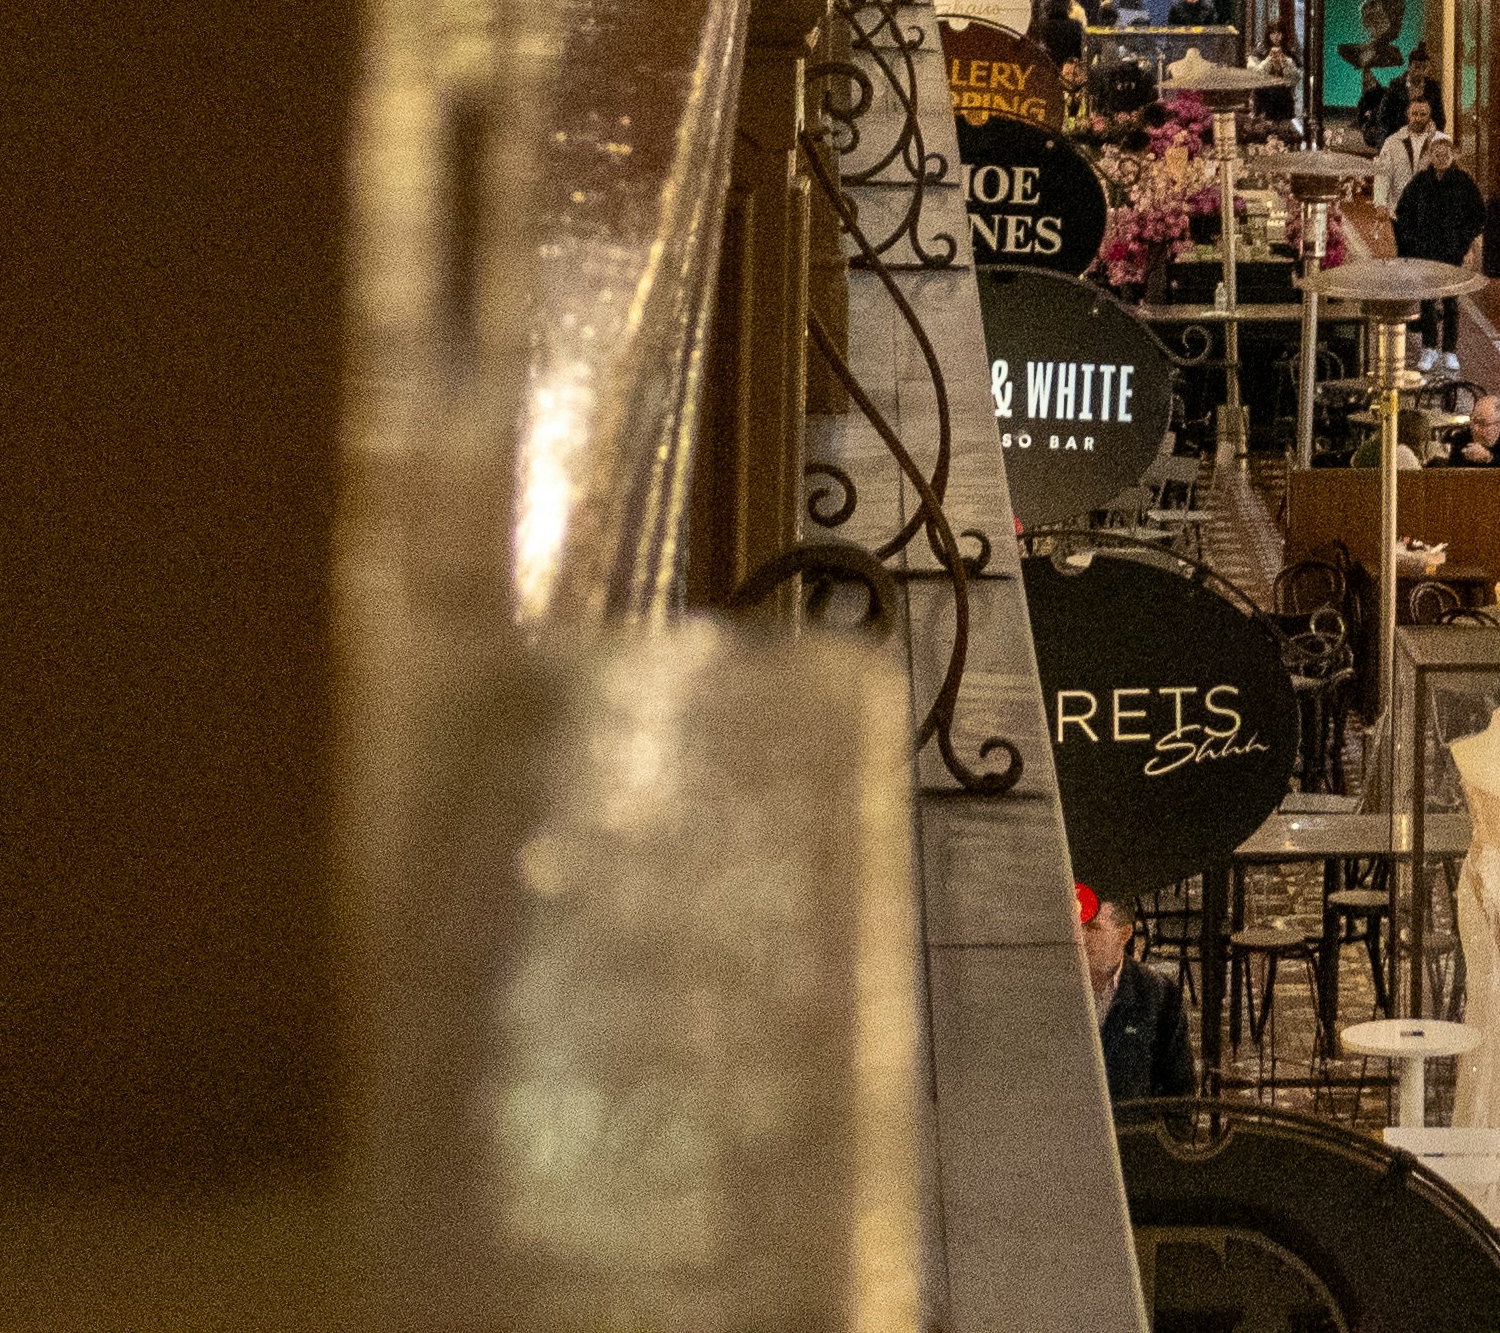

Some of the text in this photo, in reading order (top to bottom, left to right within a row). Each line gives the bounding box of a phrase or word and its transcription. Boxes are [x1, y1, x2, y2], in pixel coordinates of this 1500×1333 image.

[951, 58, 1034, 91] LERY
[1027, 361, 1135, 422] WHITE
[1001, 433, 1095, 451] SO BAR
[1057, 685, 1242, 743] RETS
